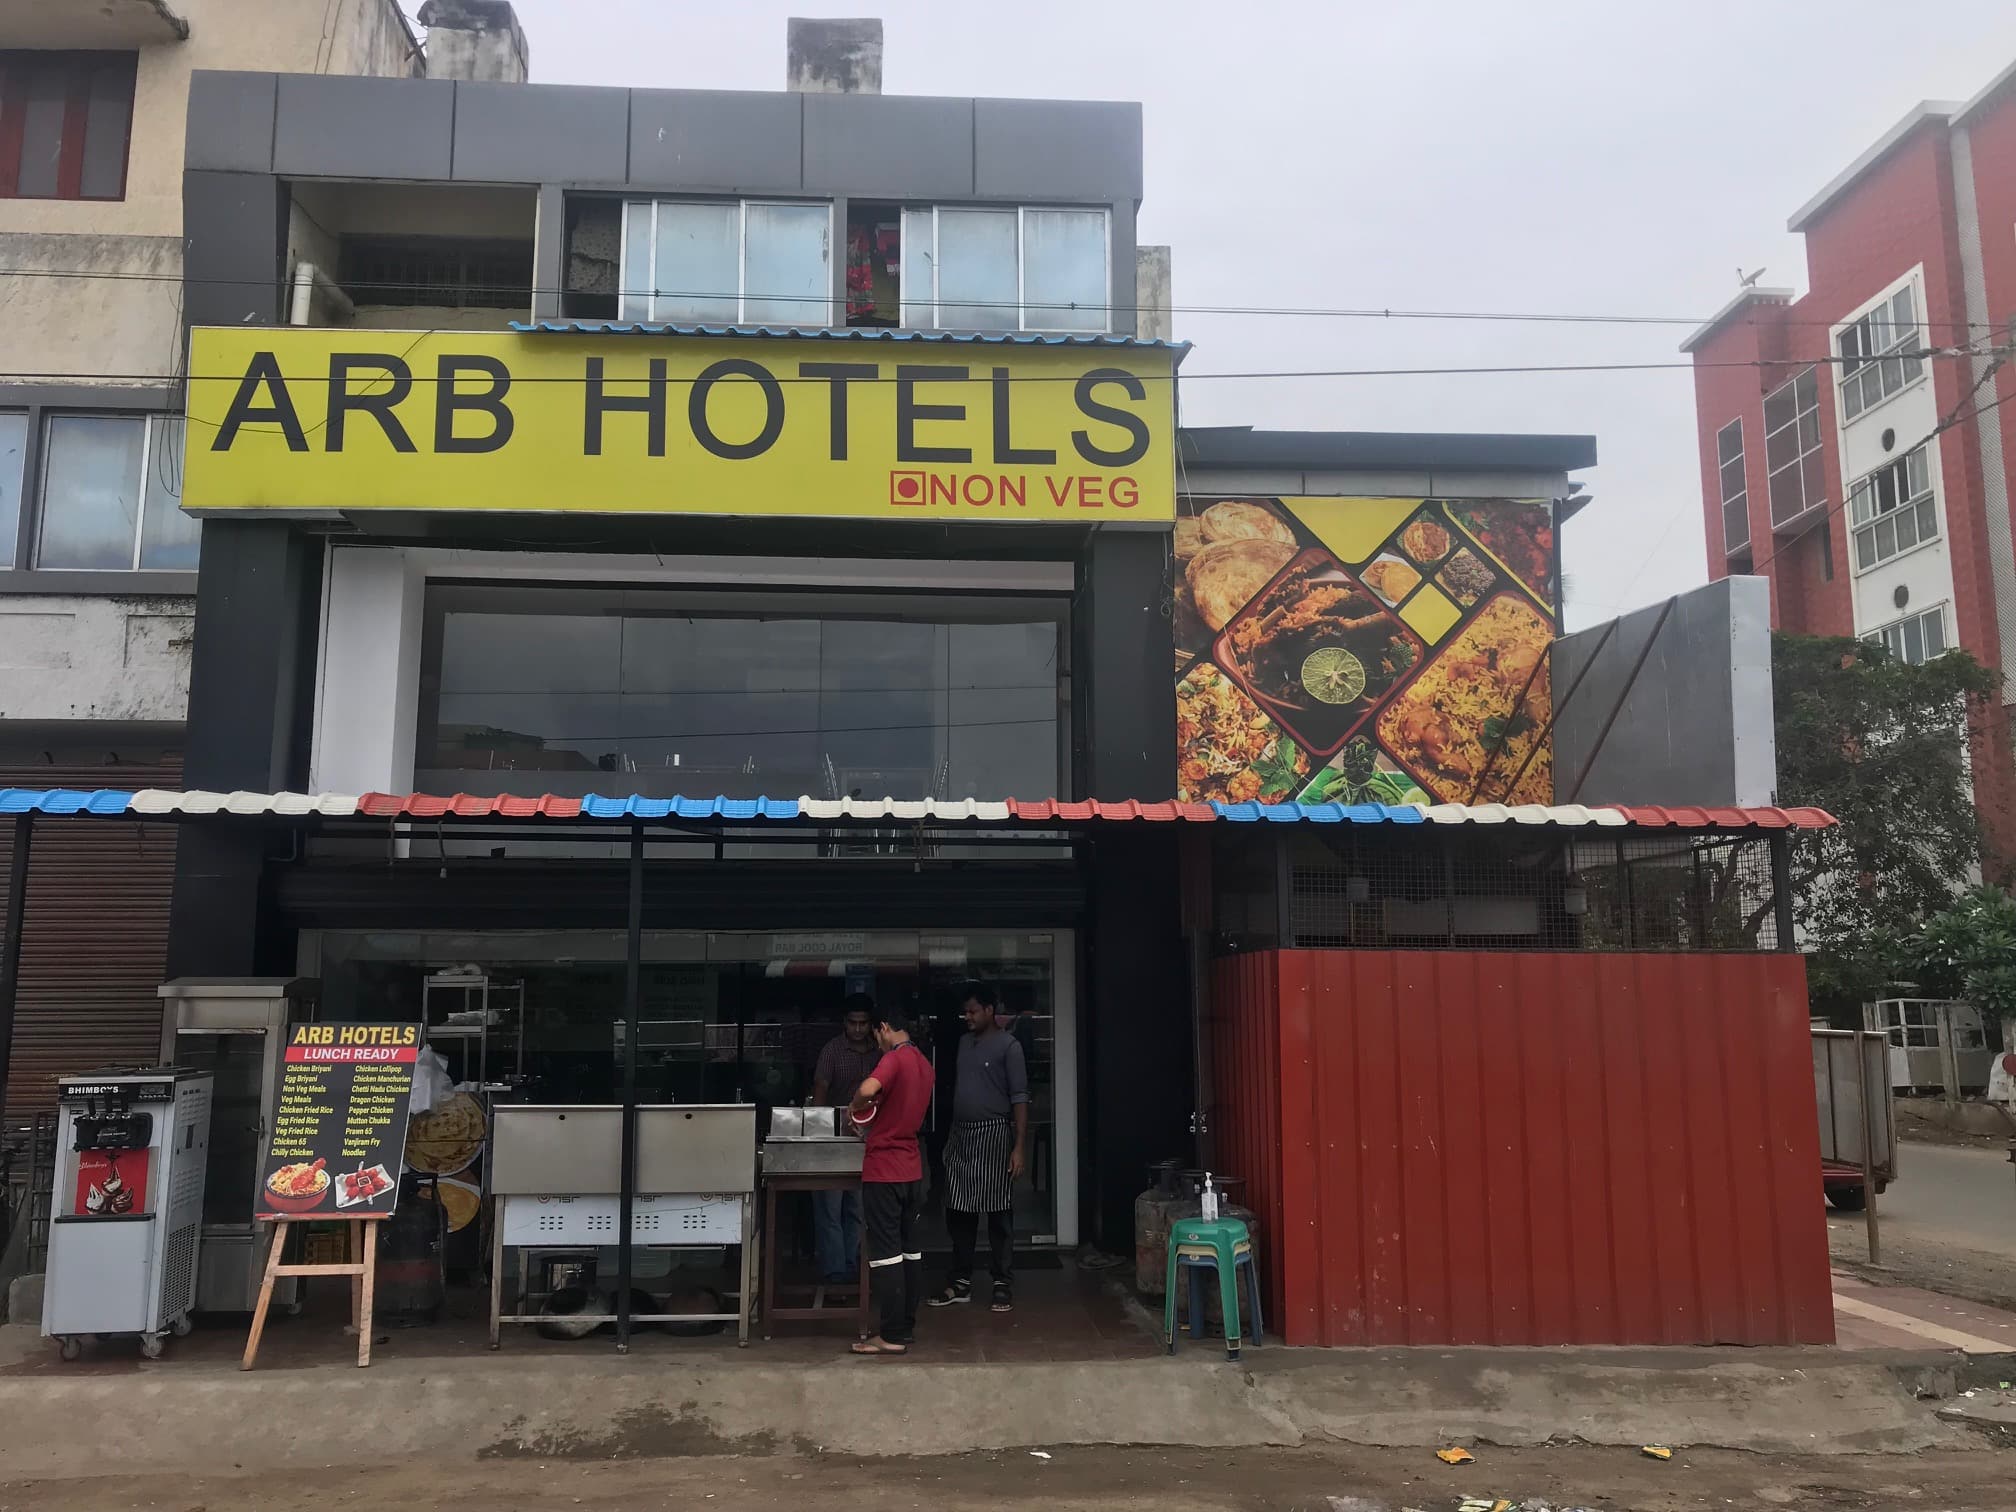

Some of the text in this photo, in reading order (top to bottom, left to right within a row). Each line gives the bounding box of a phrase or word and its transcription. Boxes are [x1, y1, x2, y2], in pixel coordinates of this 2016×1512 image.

[211, 351, 1152, 467] ARB HOTELS
[930, 475, 1140, 508] NON VEG
[293, 1026, 416, 1045] ARB HOTELS
[304, 1049, 399, 1060] LUNCH READY
[379, 1065, 402, 1074] Lollipop
[284, 1075, 296, 1084] Egg
[377, 1075, 411, 1083] Manchurian
[283, 1085, 327, 1094] Non Veg Meals
[386, 1085, 410, 1093] Chicken
[281, 1096, 293, 1104] Veg
[350, 1096, 371, 1105] Dragon
[279, 1106, 334, 1114] Chicken Fried Rice
[348, 1106, 394, 1116] Pepper Chicken
[277, 1117, 289, 1126] Egg
[369, 1116, 391, 1124] Chukka
[275, 1127, 318, 1136] Veg Fried Rice
[345, 1127, 373, 1135] Prawn 65
[370, 1138, 381, 1147] Fry
[271, 1148, 314, 1157] Chilly Chicken
[341, 1148, 366, 1156] Noodles
